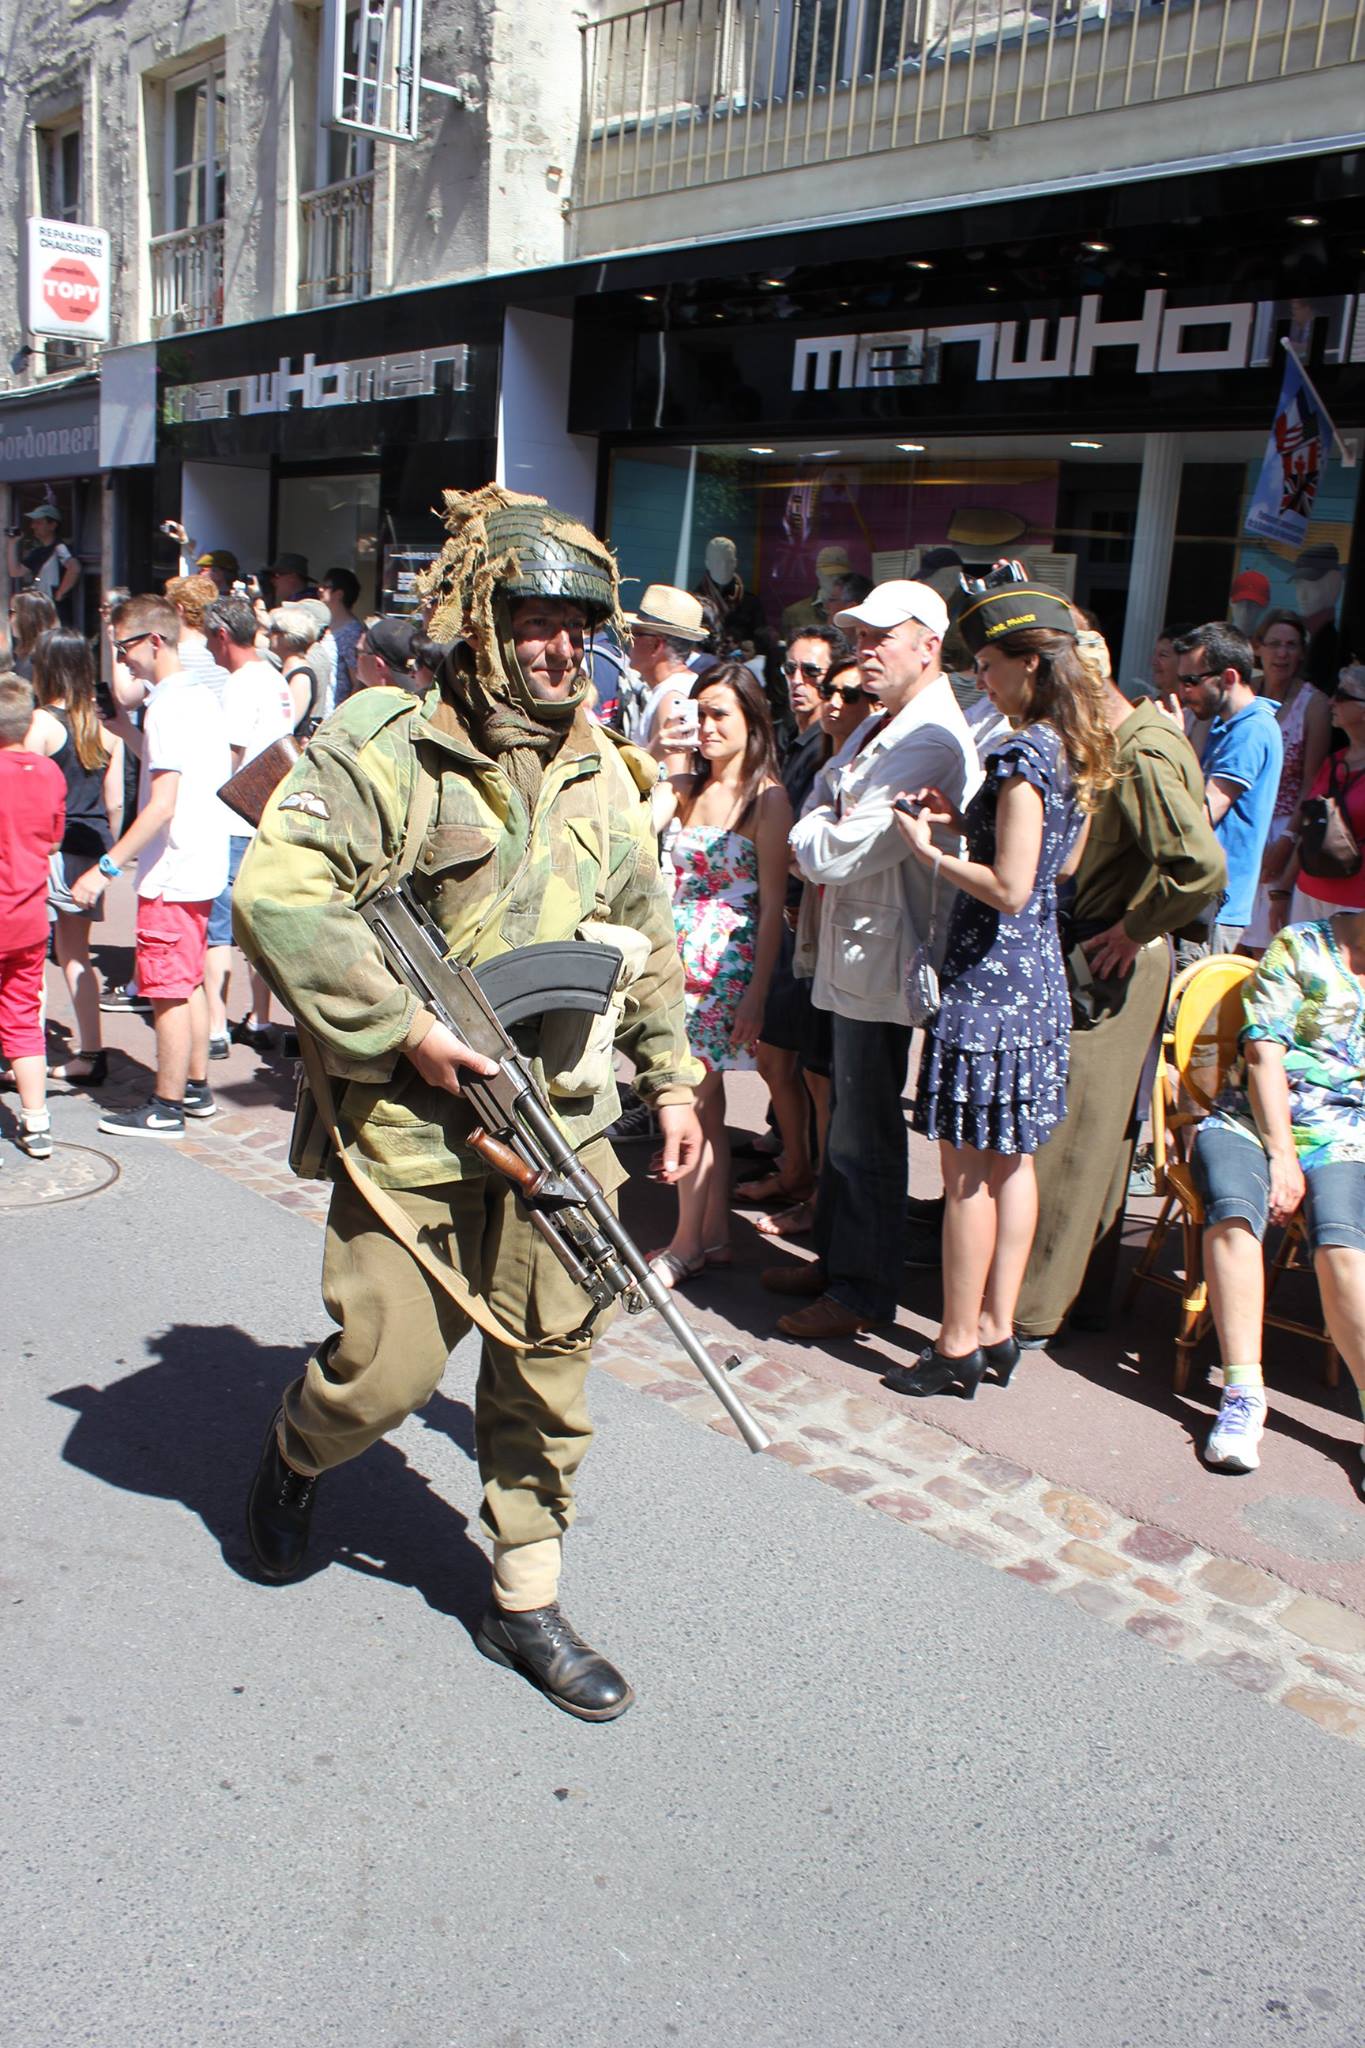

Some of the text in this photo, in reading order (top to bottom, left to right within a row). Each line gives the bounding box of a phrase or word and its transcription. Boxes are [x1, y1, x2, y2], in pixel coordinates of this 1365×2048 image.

[39, 226, 103, 245] REPARATION
[39, 238, 103, 257] CHAUSSURES
[43, 279, 100, 303] TOPY
